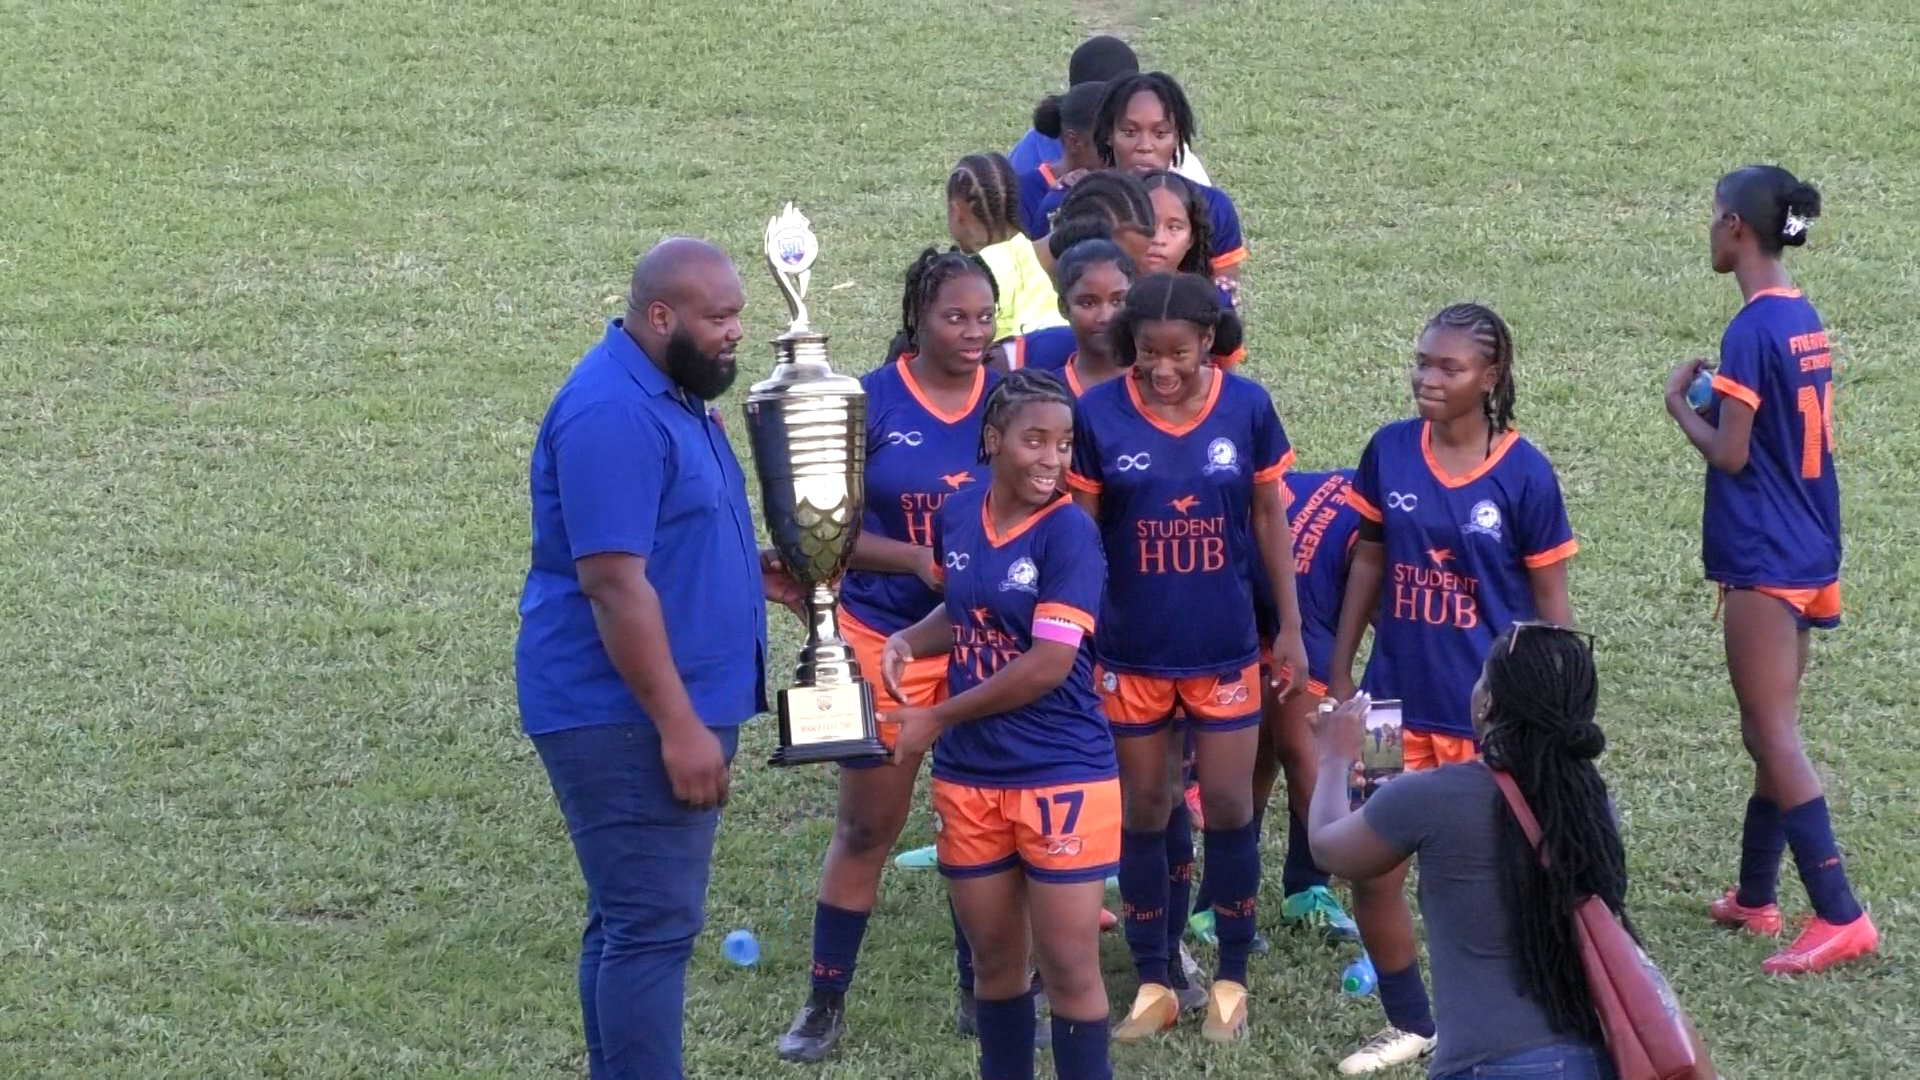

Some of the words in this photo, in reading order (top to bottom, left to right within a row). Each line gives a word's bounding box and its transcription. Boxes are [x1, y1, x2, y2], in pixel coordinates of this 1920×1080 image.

[1137, 517, 1225, 538] STUDENT
[1295, 506, 1337, 574] RIVERS
[1139, 536, 1225, 573] HUB
[1394, 563, 1479, 594] STUDENT
[1393, 583, 1478, 628] HUB
[1036, 790, 1084, 836] 17
